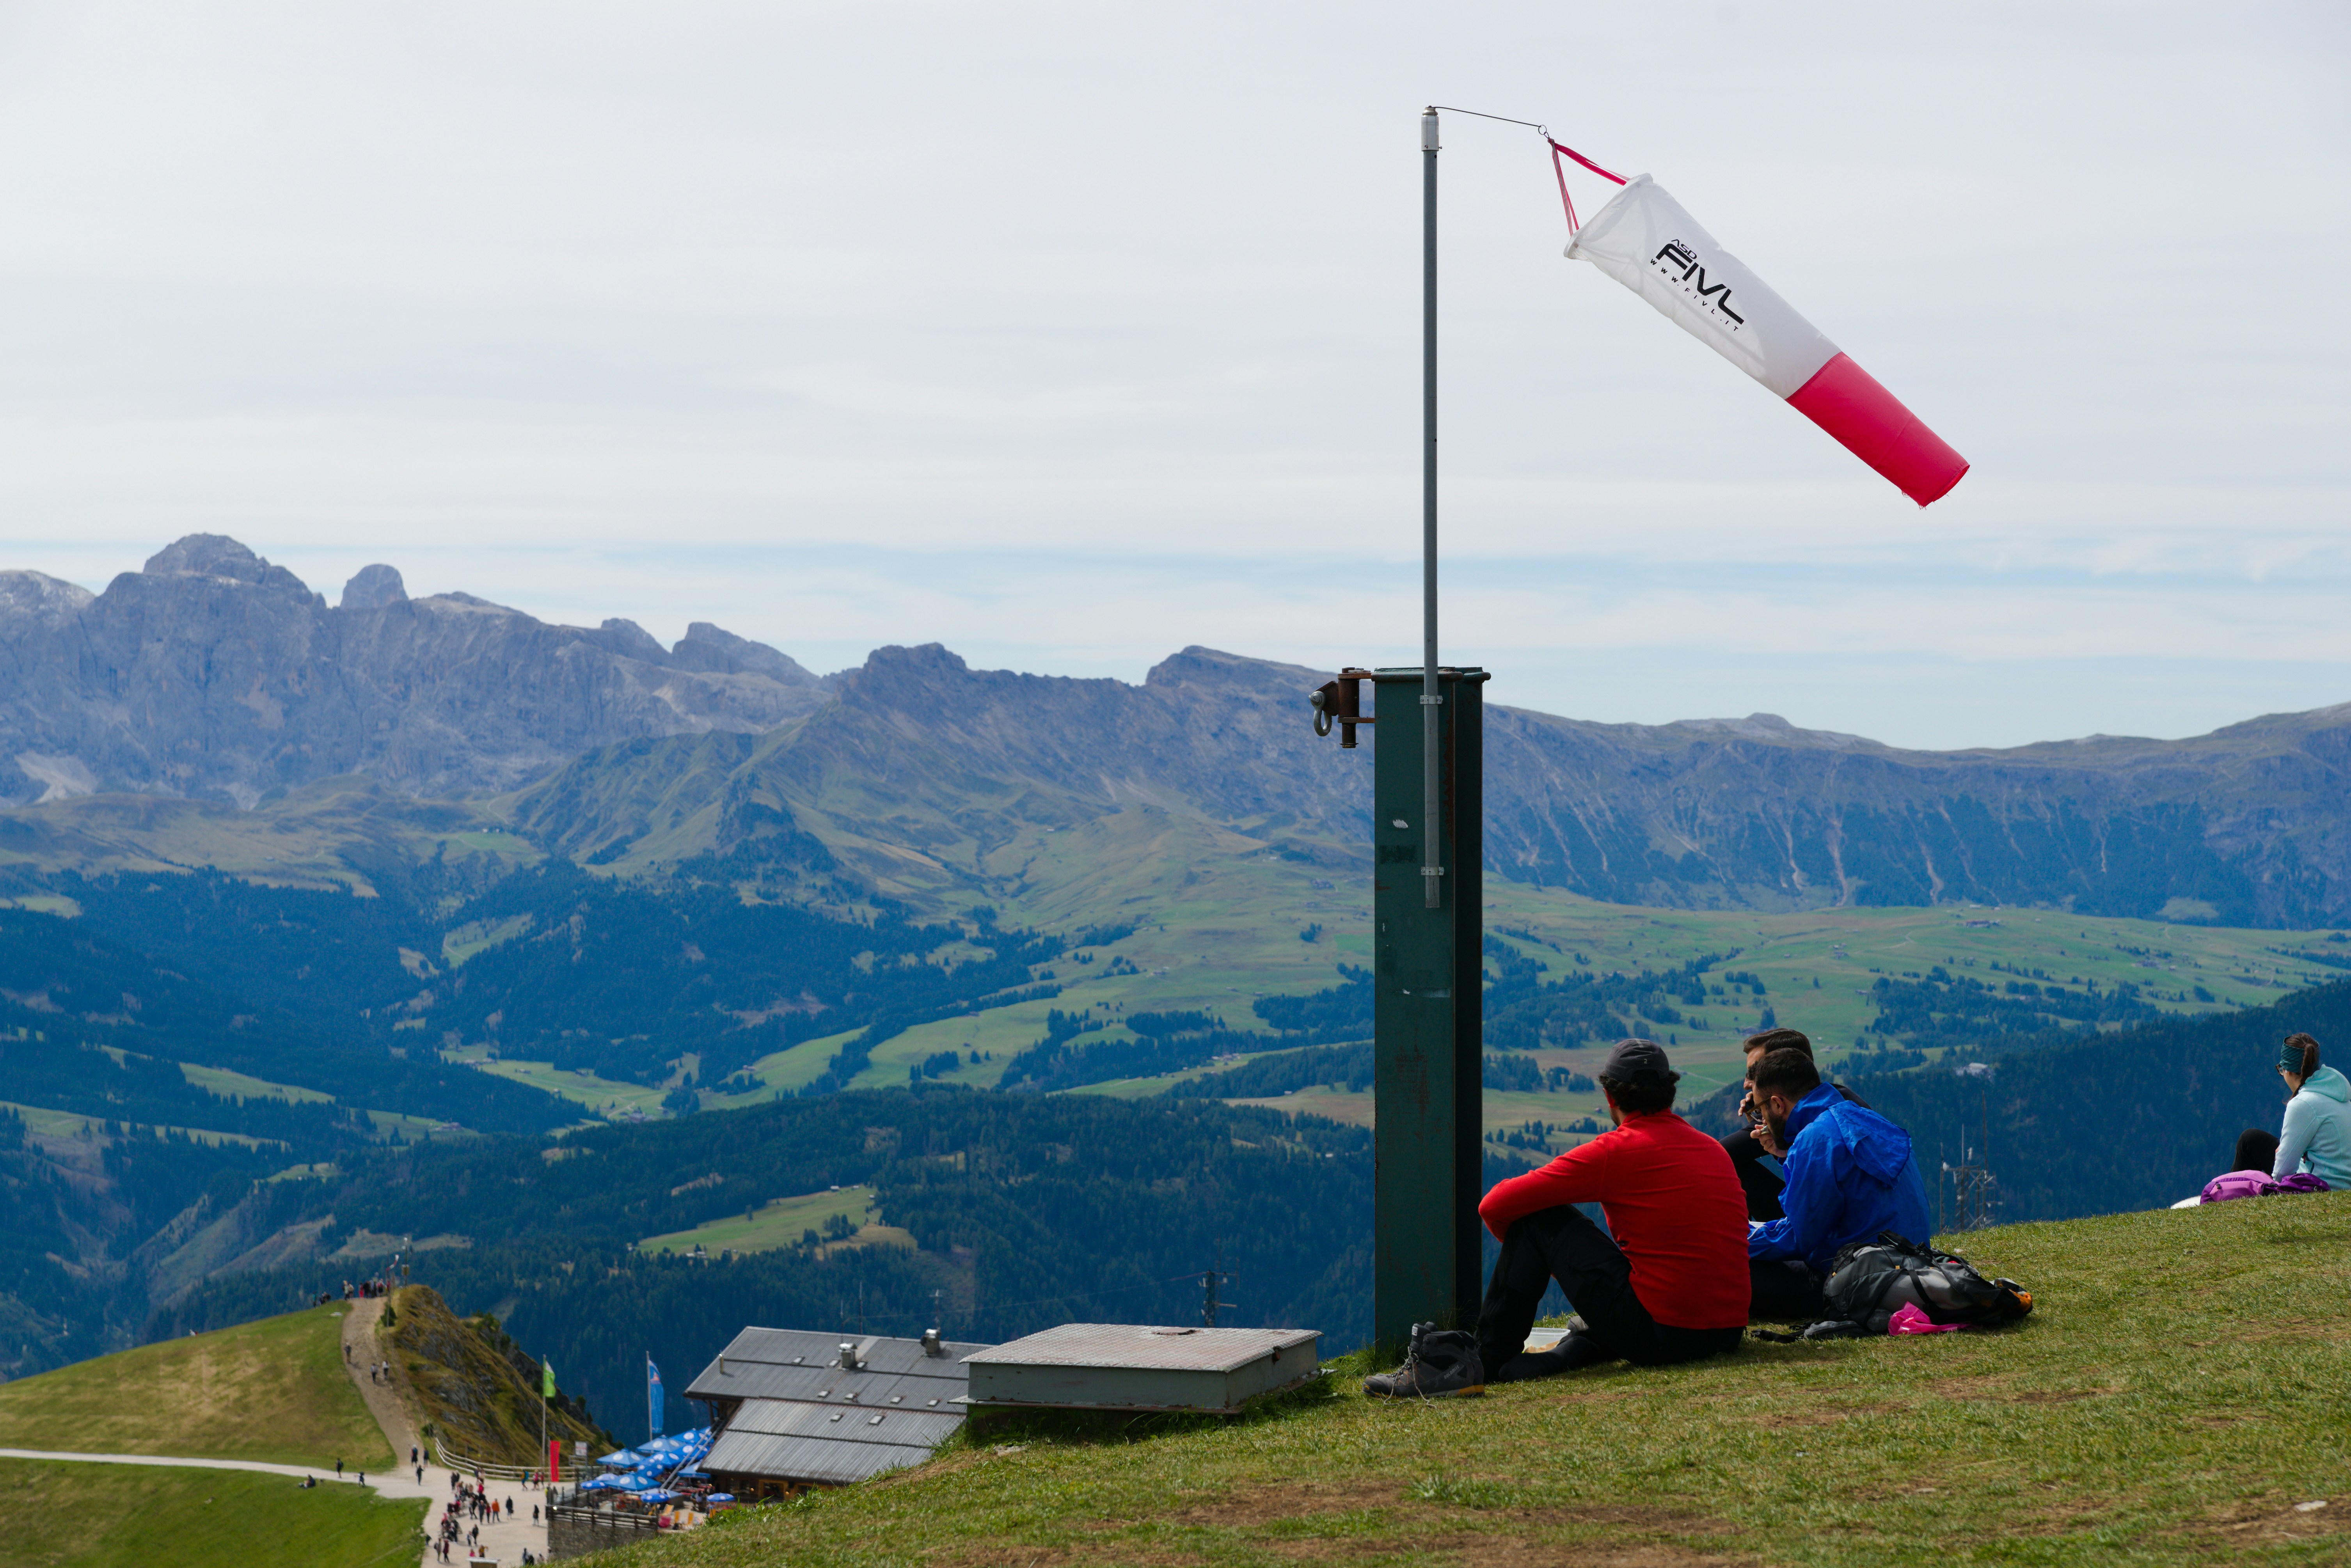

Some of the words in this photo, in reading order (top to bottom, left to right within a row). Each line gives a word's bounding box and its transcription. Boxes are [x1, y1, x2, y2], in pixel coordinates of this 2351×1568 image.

[1671, 239, 1697, 259] ASD
[1650, 259, 1738, 331] WWW.FIVL.IT
[1656, 243, 1744, 325] FIVL
[1444, 1364, 1460, 1379] DOLOMITE
